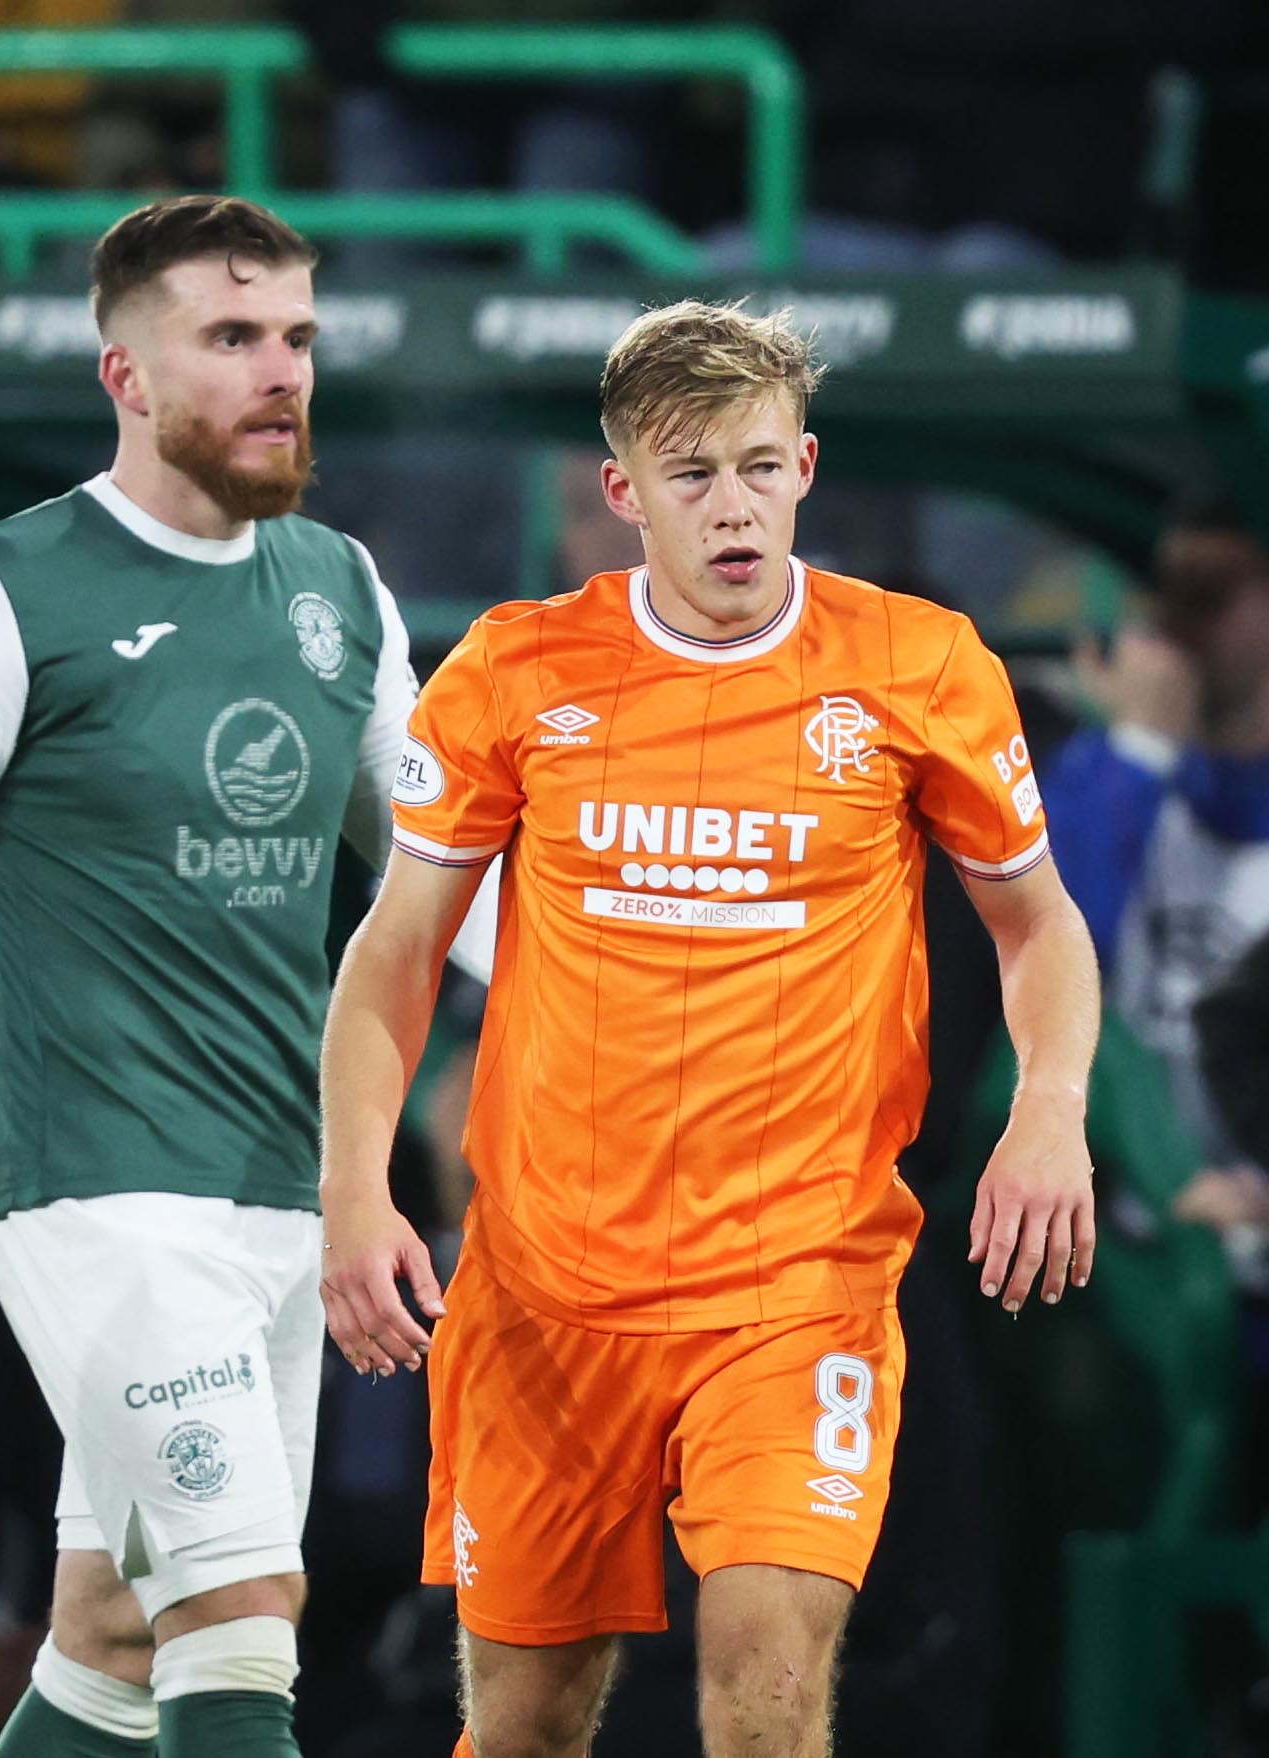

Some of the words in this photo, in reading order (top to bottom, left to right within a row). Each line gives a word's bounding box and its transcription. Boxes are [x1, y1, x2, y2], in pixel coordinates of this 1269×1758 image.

[539, 733, 591, 745] umbro
[578, 801, 819, 862] UNIBET
[176, 825, 323, 888] bevvy
[226, 885, 285, 908] .com
[611, 896, 682, 920] ZERO%
[691, 904, 777, 924] MISSION
[124, 1357, 235, 1411] Capital
[814, 1352, 873, 1474] 8
[810, 1501, 857, 1520] umbro
